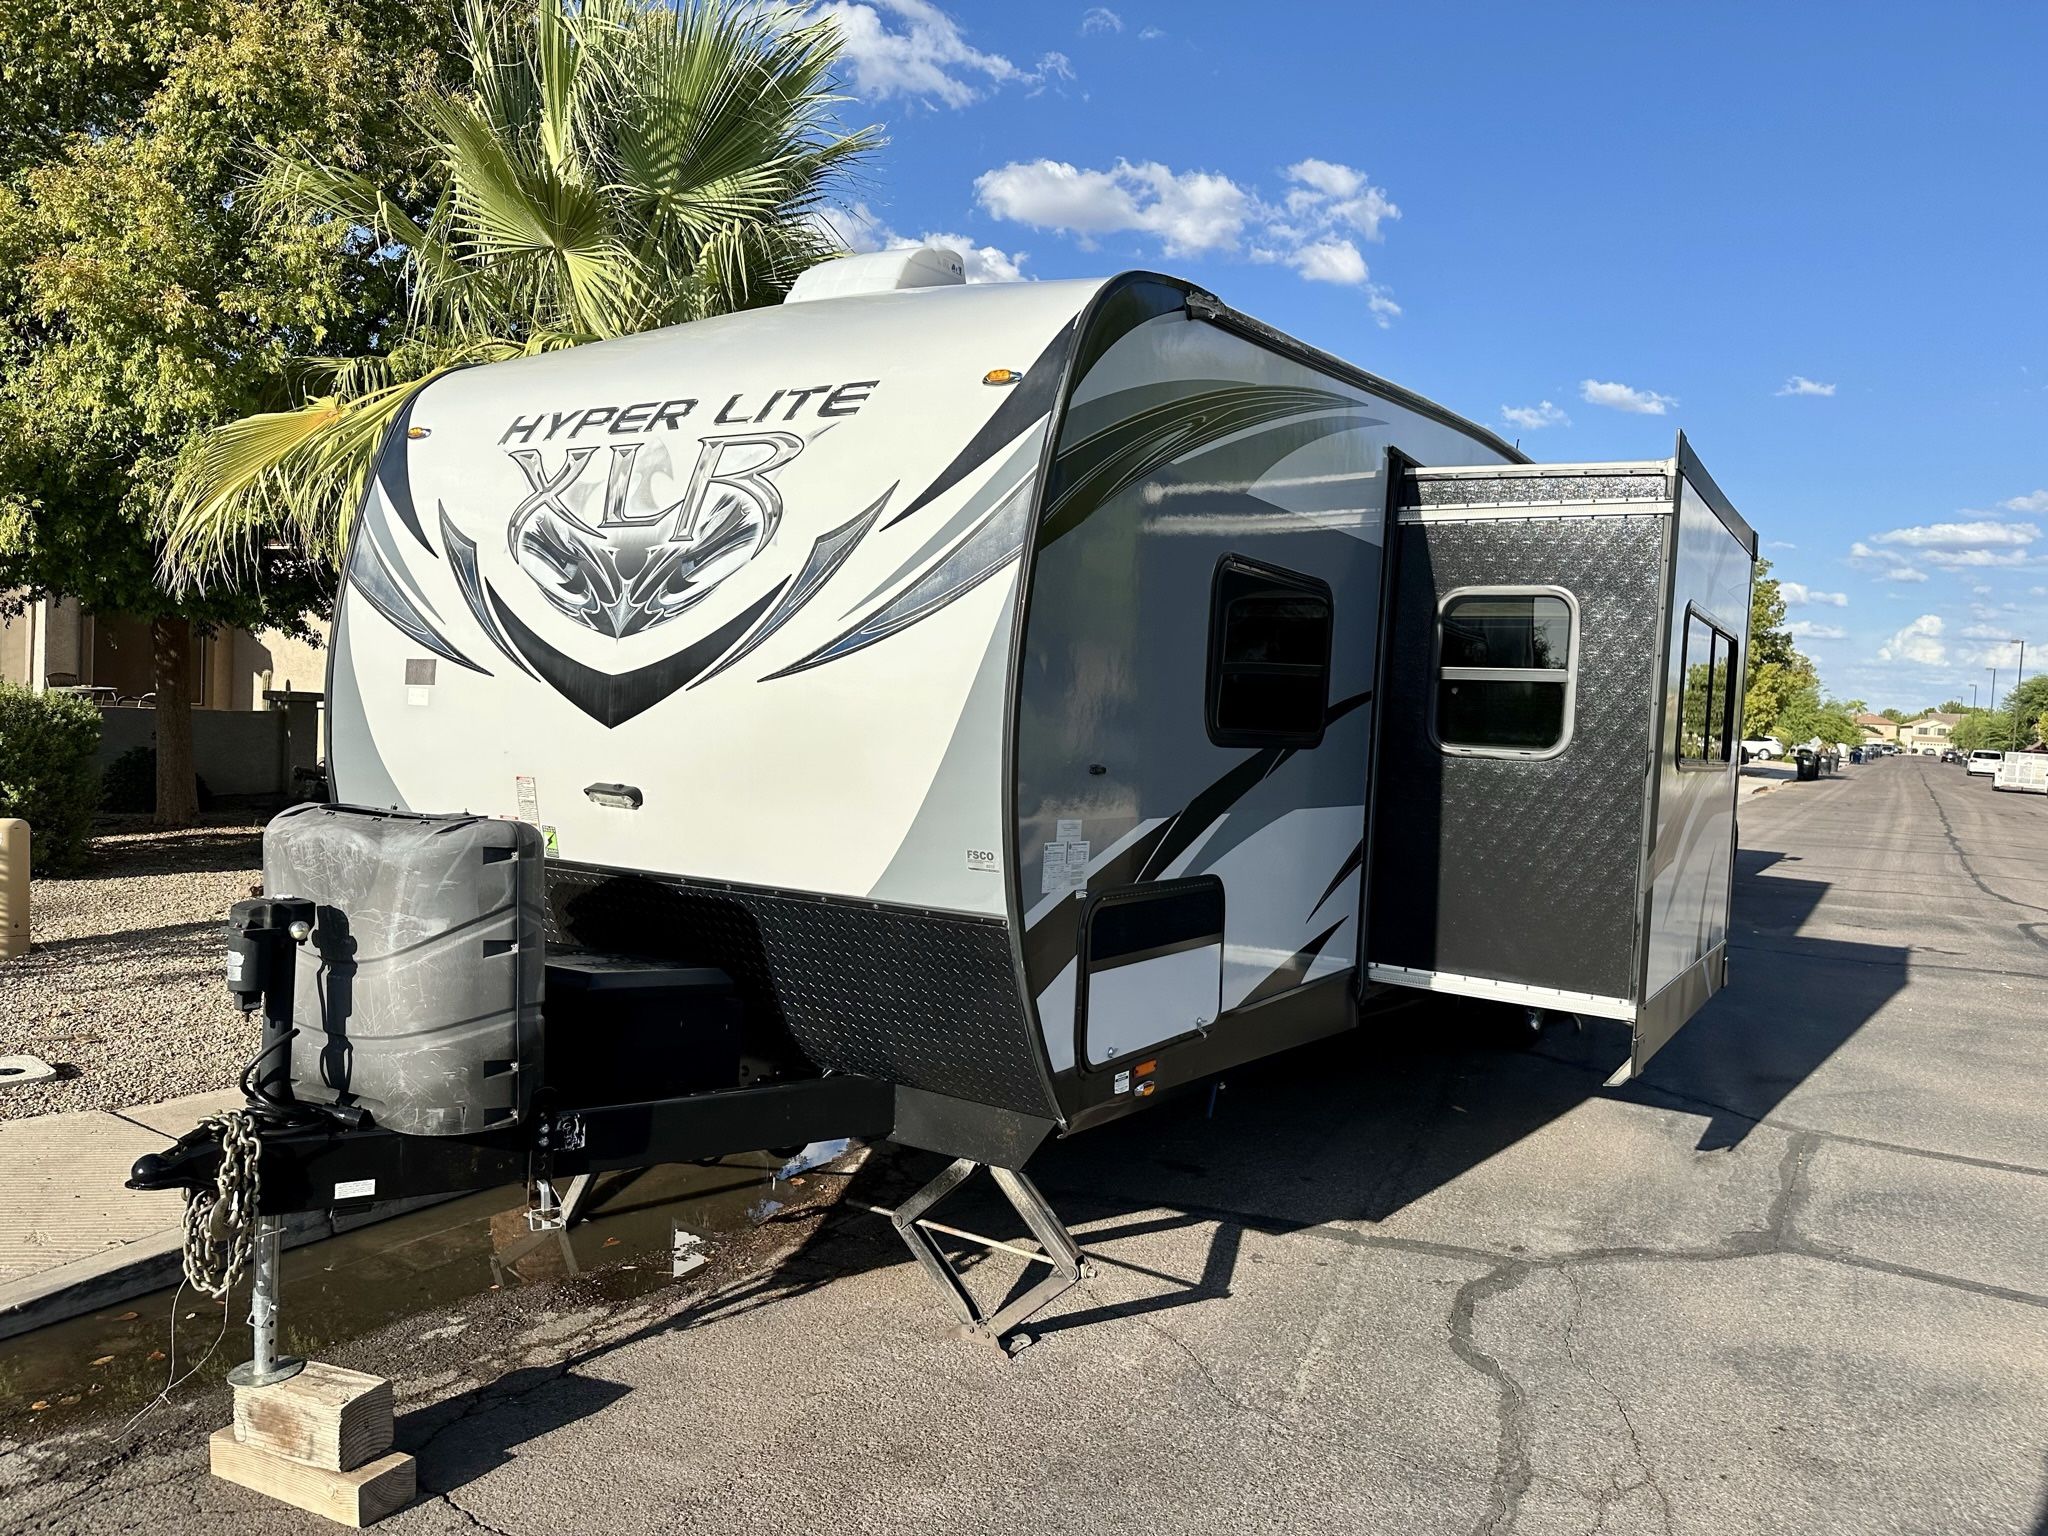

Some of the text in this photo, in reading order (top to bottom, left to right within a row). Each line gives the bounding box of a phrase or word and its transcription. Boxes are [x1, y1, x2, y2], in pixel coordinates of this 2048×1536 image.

[498, 380, 880, 445] HYPER LITE
[507, 430, 805, 565] XLR
[967, 850, 994, 861] FSCO
